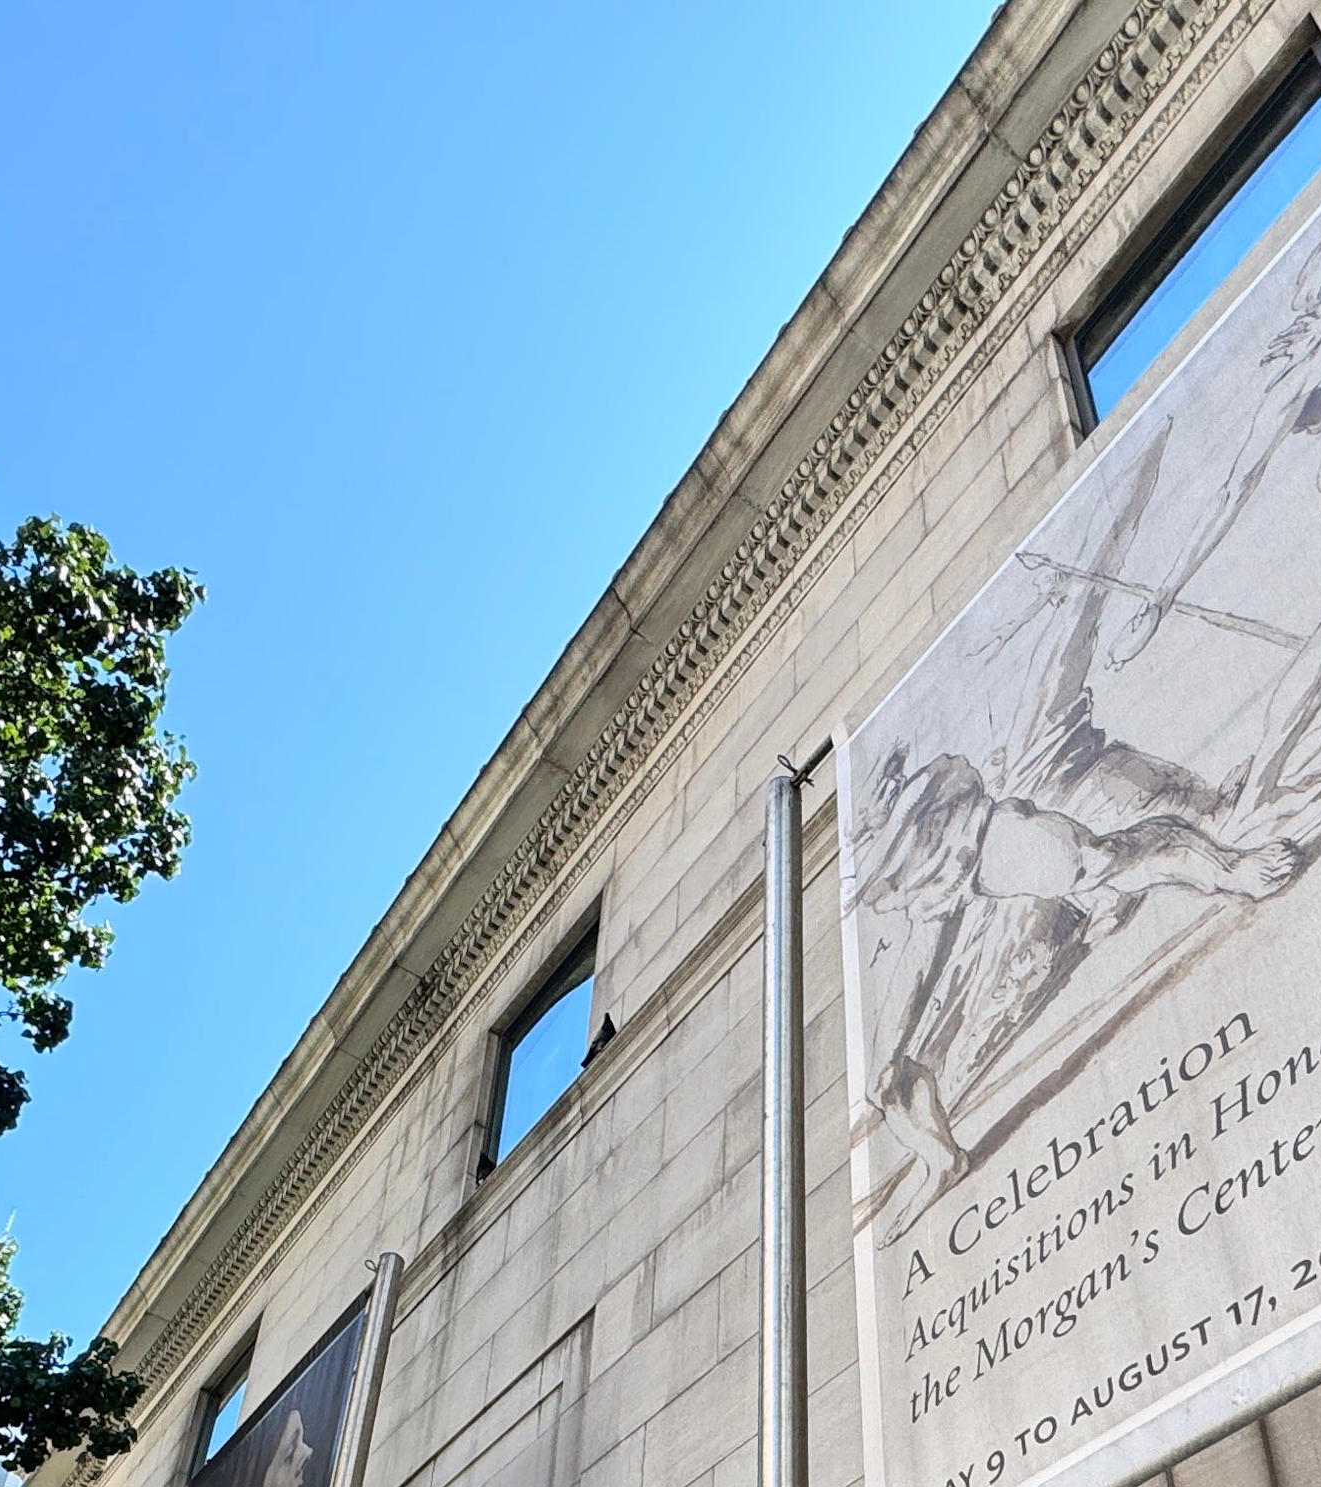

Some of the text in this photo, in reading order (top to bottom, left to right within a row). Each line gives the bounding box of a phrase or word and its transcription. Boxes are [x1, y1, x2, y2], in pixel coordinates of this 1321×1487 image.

[903, 1006, 1259, 1299] A Celebration
[905, 1172, 1135, 1363] Acquisitions
[1149, 1134, 1197, 1184] in
[909, 1366, 961, 1425] the
[973, 1224, 1161, 1384] Morgan's
[986, 1449, 1007, 1487] 9
[1015, 1414, 1058, 1459] TO
[1070, 1320, 1213, 1428] AUGUST
[1226, 1285, 1281, 1334] 17,
